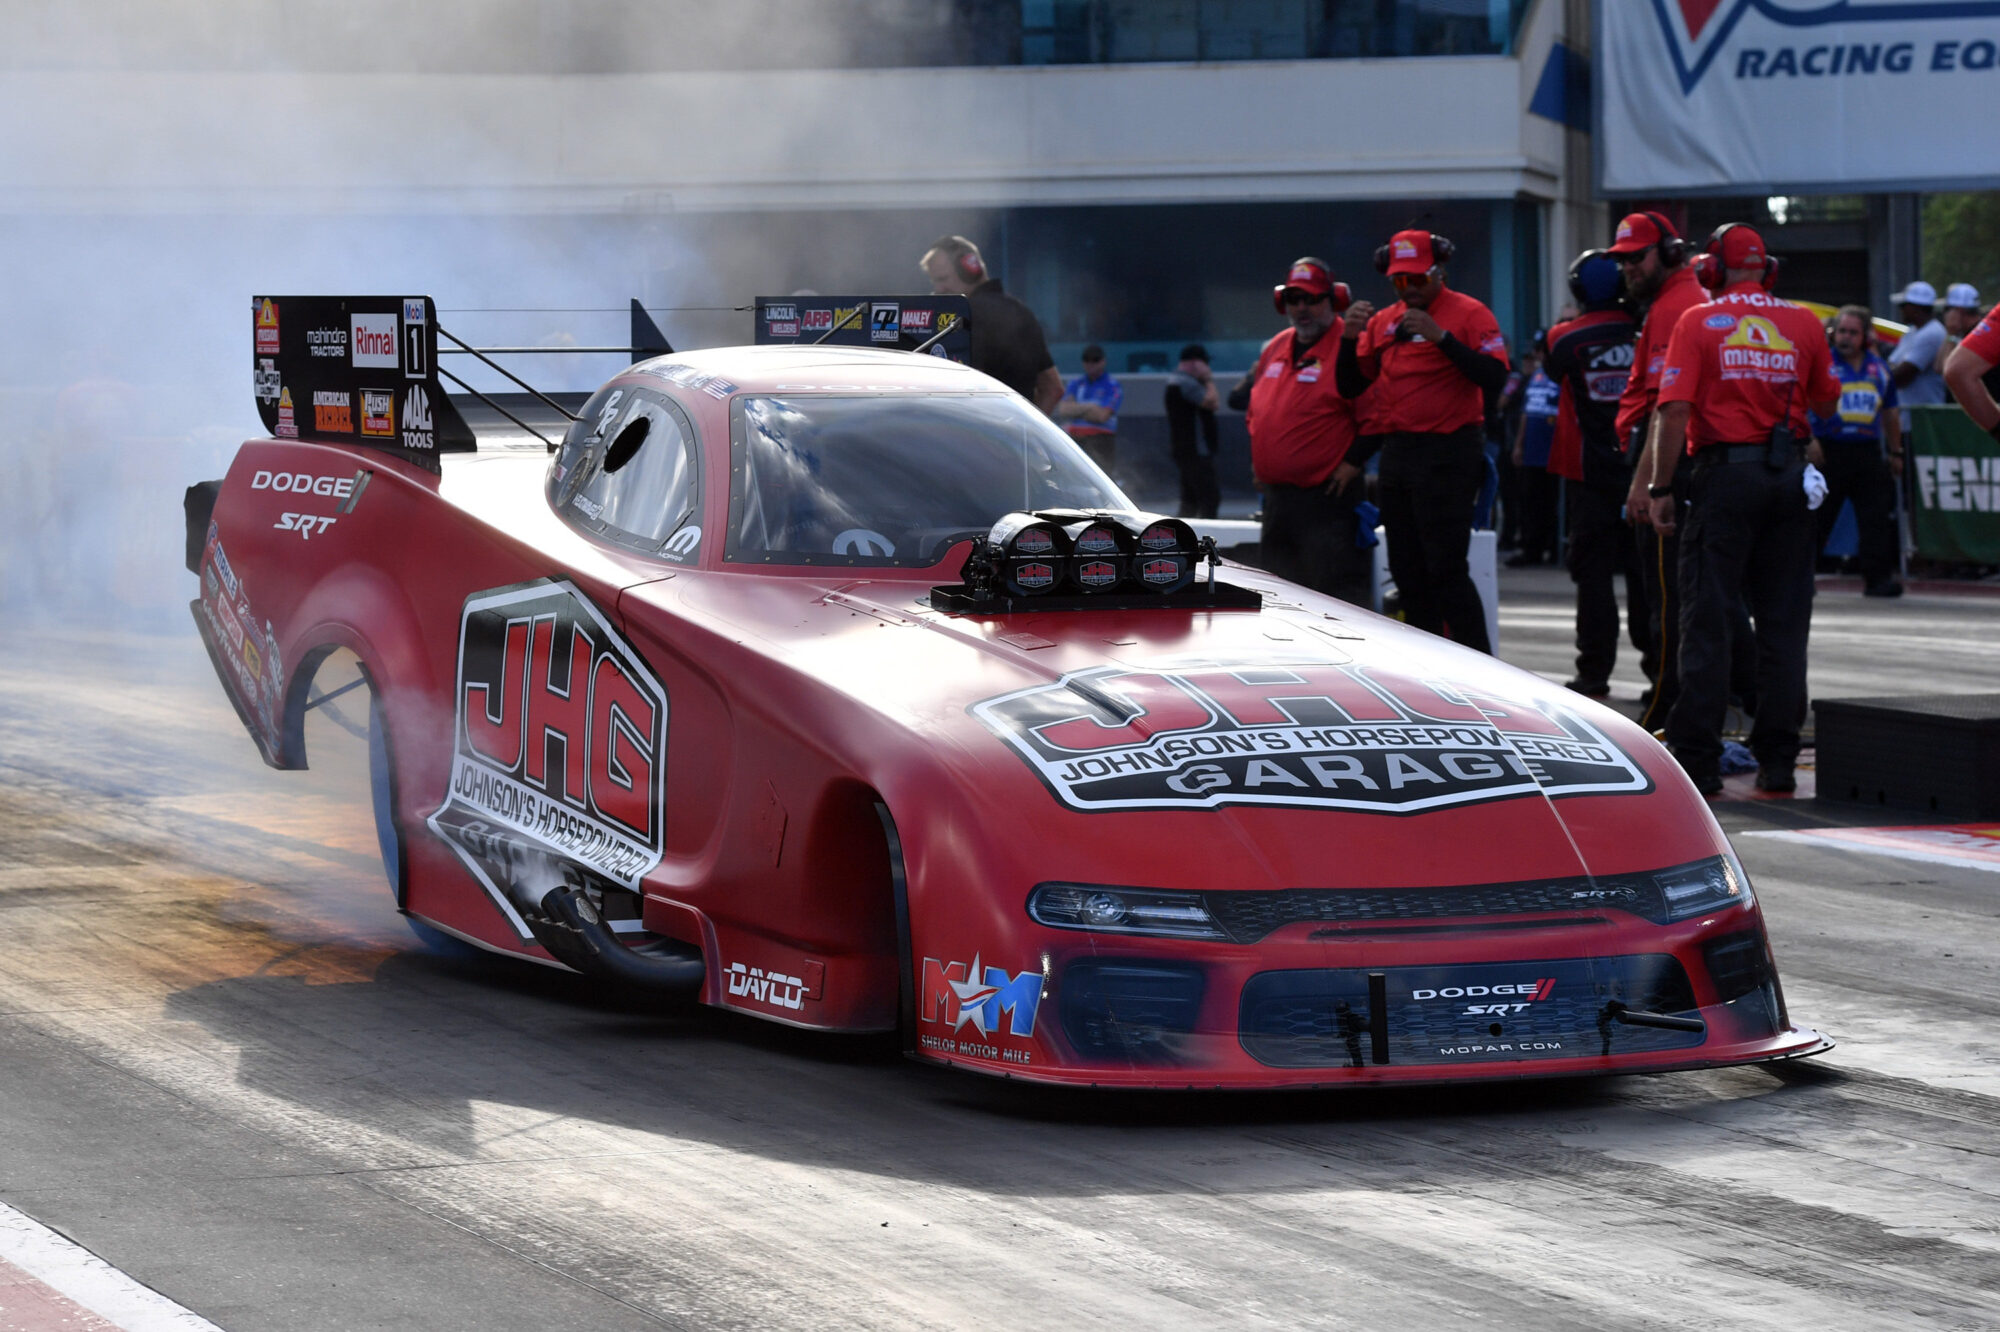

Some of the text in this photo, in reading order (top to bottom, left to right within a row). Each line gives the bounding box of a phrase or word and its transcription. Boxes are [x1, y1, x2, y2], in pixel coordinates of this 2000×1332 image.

[1735, 40, 2000, 79] RACING EQ
[404, 303, 424, 320] Mobil
[766, 306, 795, 320] LINCOLN
[802, 311, 832, 327] ARP
[902, 311, 931, 326] MANLEY
[306, 326, 347, 344] mahindra
[355, 326, 396, 356] Rinnai
[871, 329, 899, 340] CARRILLO
[310, 345, 345, 357] TRACTORS
[410, 327, 419, 370] 1
[313, 390, 350, 407] AMERICAN
[364, 391, 390, 416] RUSH
[402, 384, 433, 430] MAC
[315, 405, 354, 433] REBEL
[402, 431, 434, 449] TOOLS
[251, 470, 354, 498] DODGE
[1914, 454, 2000, 512] FEN
[273, 511, 337, 540] SRT
[656, 552, 684, 563] MOPAR
[215, 542, 238, 600] MAHLE
[1019, 564, 1051, 578] JHG
[1081, 564, 1115, 577] JHG
[1145, 562, 1177, 575] JHG
[465, 612, 656, 844] JHG
[1060, 727, 1614, 782] JOHNSON'S HORSEPOWERED
[1165, 752, 1554, 795] GARAGE
[454, 762, 650, 884] JOHNSON'S HORSEPOWERED
[1571, 889, 1621, 900] SRT
[728, 961, 803, 1010] DAYCO
[1412, 983, 1540, 1000] DODGE
[1461, 1003, 1532, 1016] SRT
[921, 1035, 1032, 1065] SHELOR MOTOR MILE
